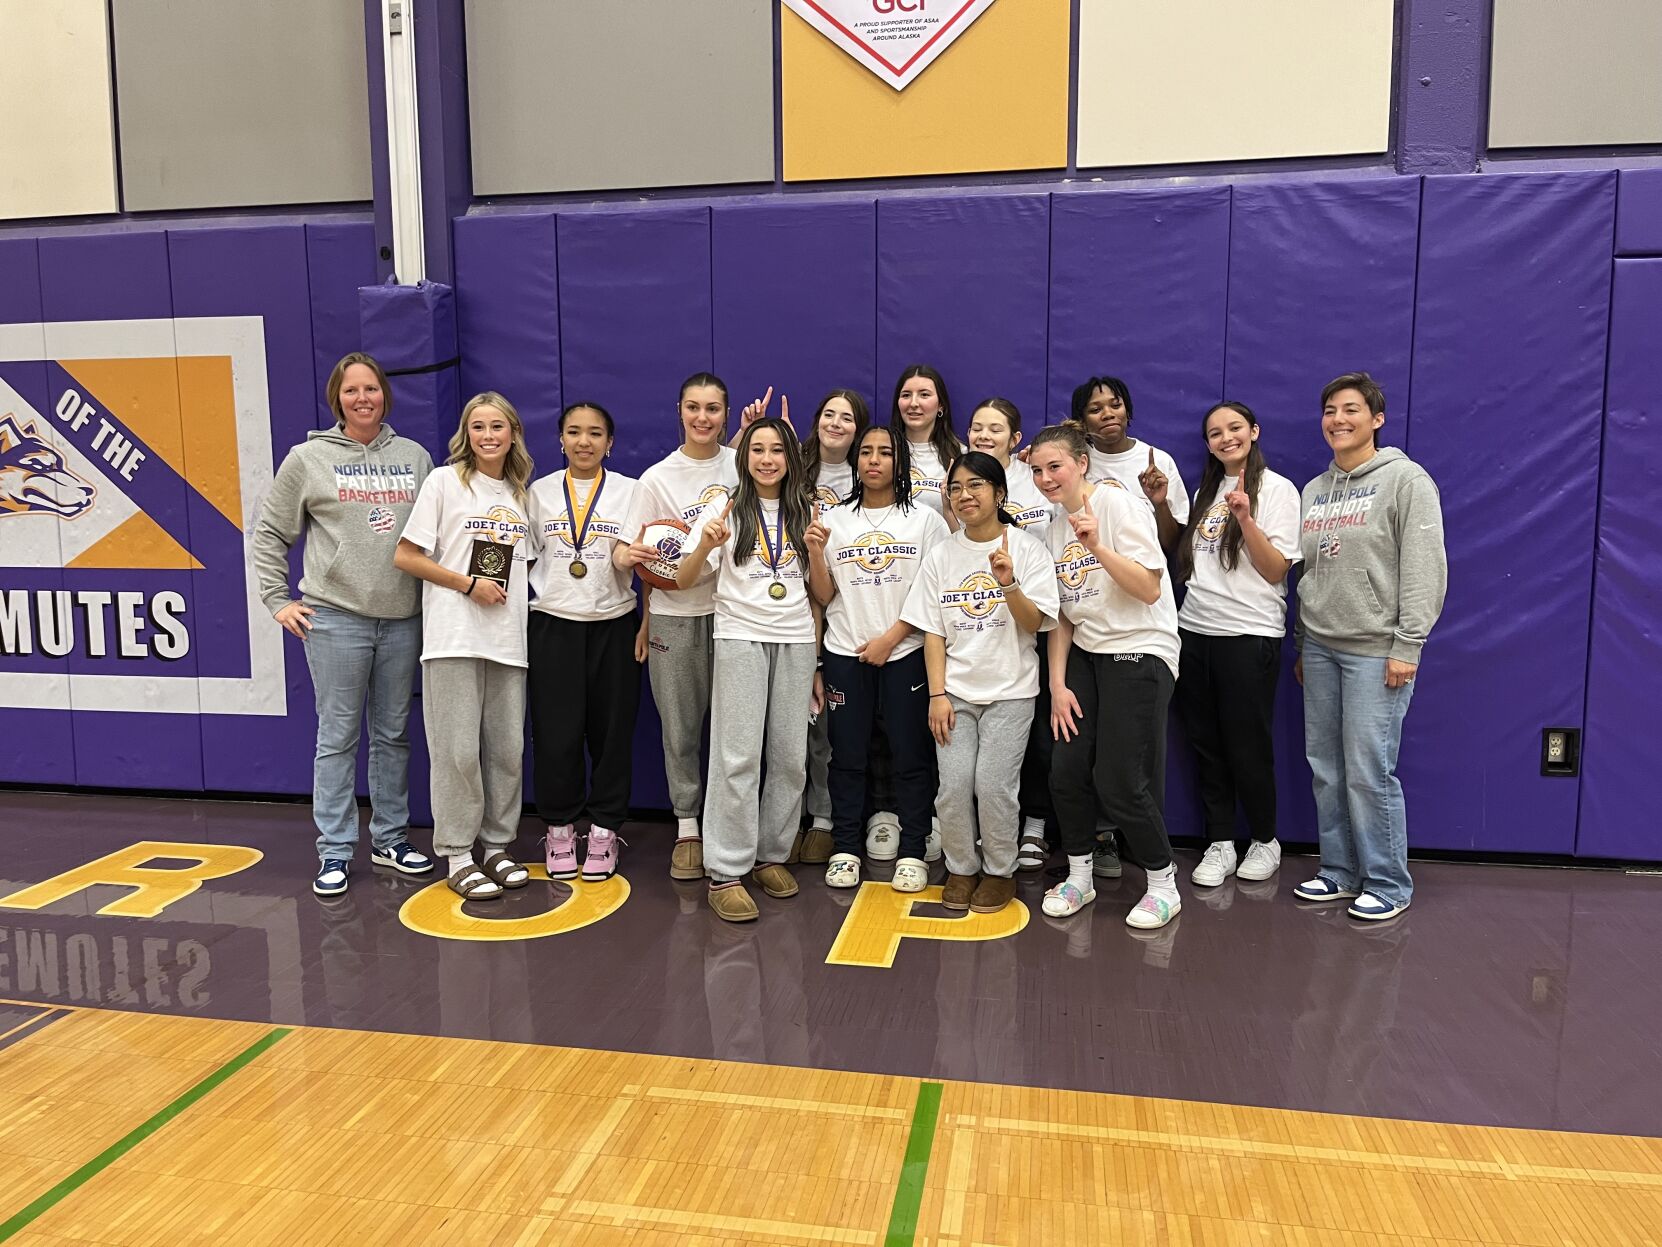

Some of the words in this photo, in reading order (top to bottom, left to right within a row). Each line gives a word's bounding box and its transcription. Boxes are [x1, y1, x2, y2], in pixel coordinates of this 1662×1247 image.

[872, 0, 925, 14] GCI
[880, 19, 913, 27] SUPPORTER
[880, 25, 927, 34] SPORTSMANSHIP
[55, 388, 97, 432] OF
[90, 417, 146, 482] THE
[333, 463, 378, 476] NORTH
[335, 474, 416, 490] PATRIOTS
[338, 487, 416, 504] BASKETBALL
[1348, 484, 1379, 500] POLE
[1305, 496, 1375, 519] PATRIOTS
[1014, 509, 1045, 522] ASSIC
[499, 523, 527, 535] CLAS
[588, 523, 620, 535] ASSIC
[868, 545, 917, 555] CLASSIC
[973, 590, 1005, 600] CLAS
